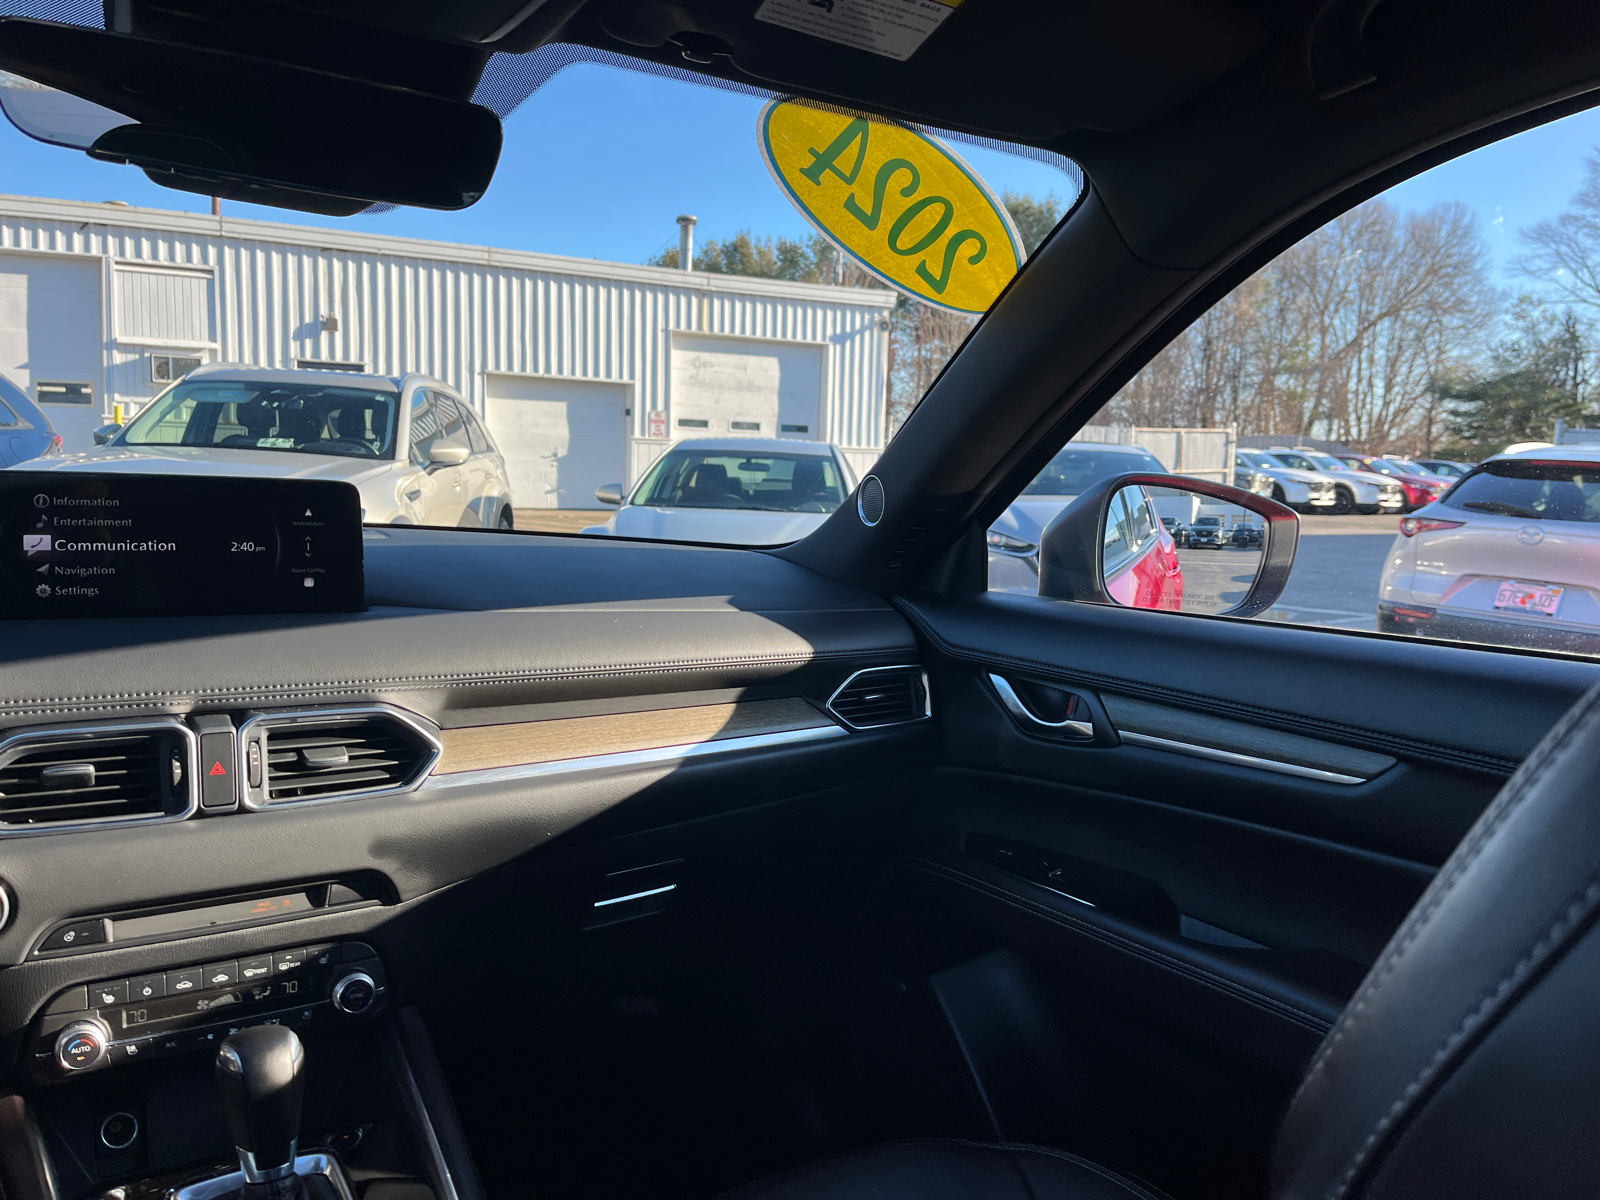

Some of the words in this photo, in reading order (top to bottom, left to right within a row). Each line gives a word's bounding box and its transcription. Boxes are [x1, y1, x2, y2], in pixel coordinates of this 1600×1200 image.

[919, 2, 942, 13] BAGS
[53, 496, 120, 507] Information
[53, 516, 133, 527] Entertainment
[54, 539, 176, 552] Communication
[230, 541, 255, 552] 2:40
[54, 565, 116, 577] Navigation
[54, 585, 100, 597] Settings
[281, 980, 298, 993] 70
[349, 991, 366, 999] SYNC
[128, 1009, 147, 1023] 70
[70, 1045, 92, 1055] AUTO
